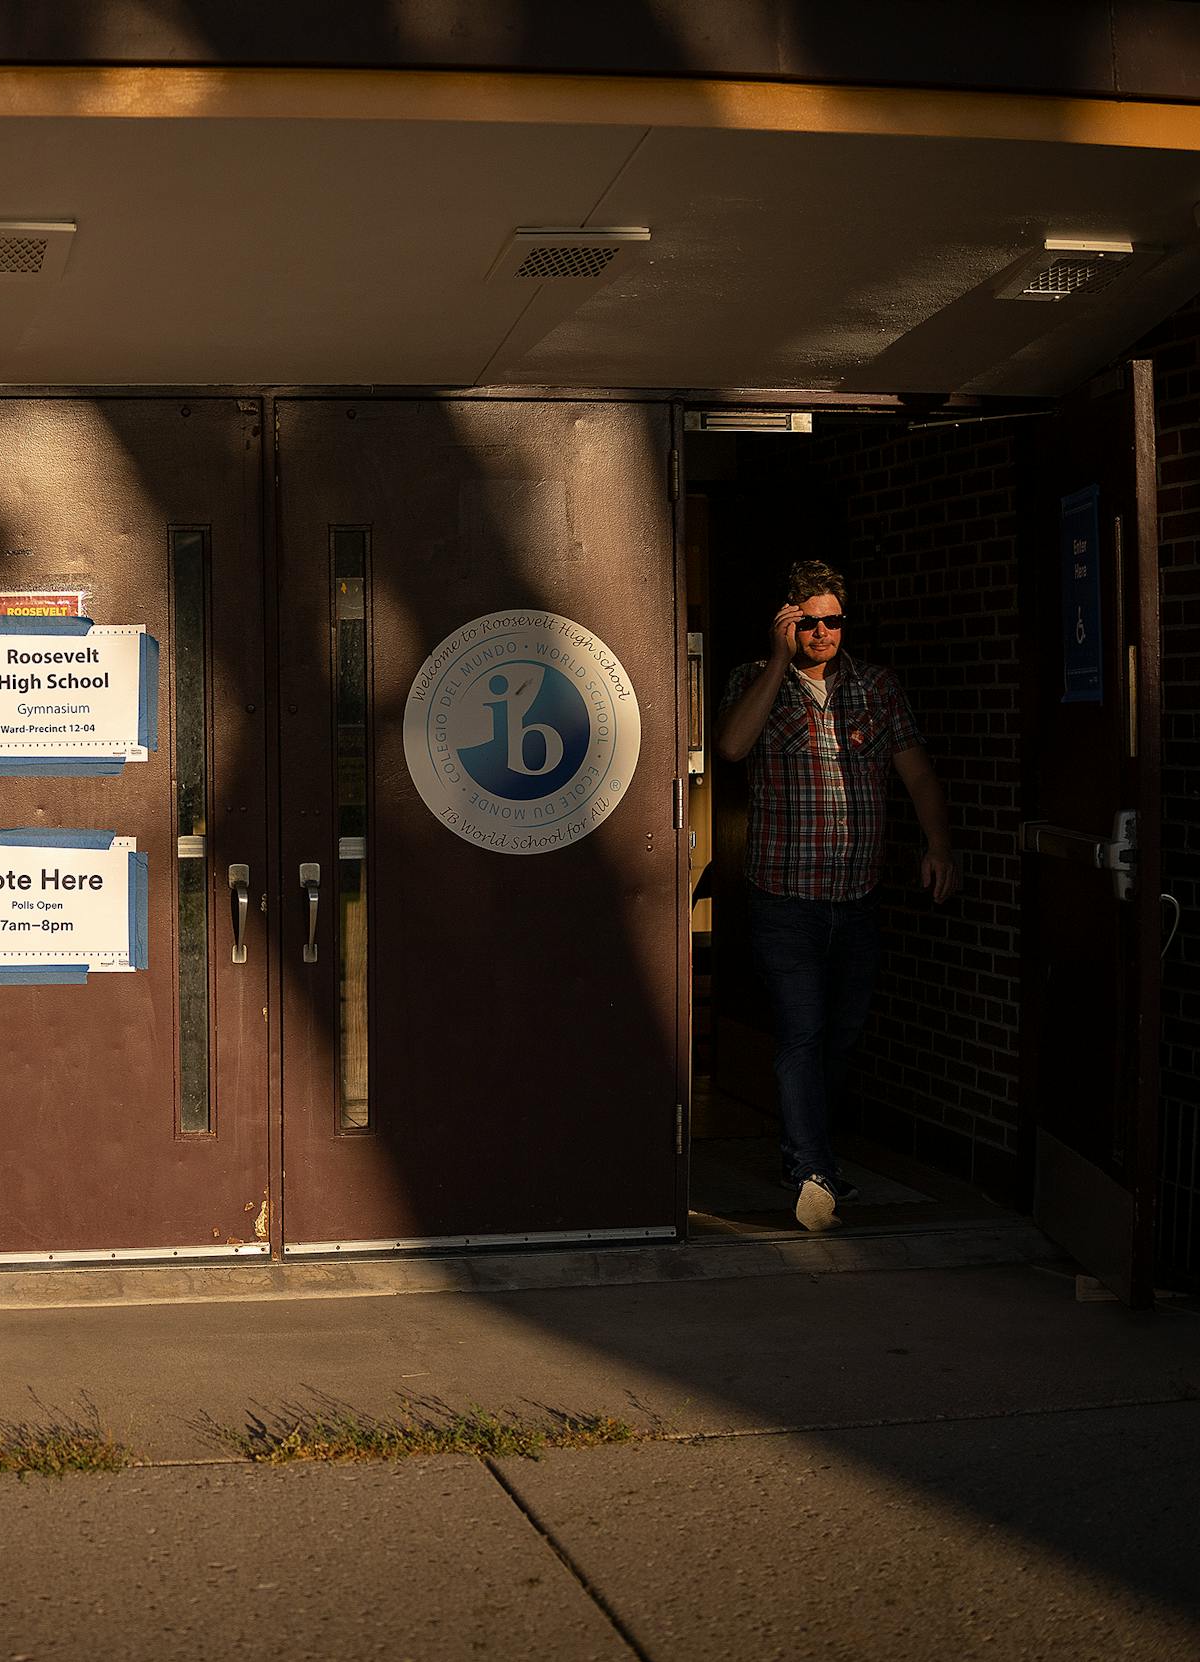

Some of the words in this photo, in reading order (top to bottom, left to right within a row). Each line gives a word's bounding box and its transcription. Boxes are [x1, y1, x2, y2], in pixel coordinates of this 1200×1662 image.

[6, 607, 68, 616] ROOSEVELT
[6, 647, 100, 665] Roosevelt
[412, 639, 461, 702] Welcome
[462, 628, 479, 642] to
[480, 615, 558, 634] Roosevelt
[558, 623, 597, 652] High
[593, 650, 631, 701] School
[460, 641, 517, 677] MUNDO
[47, 672, 110, 690] School
[441, 679, 463, 713] DEL
[536, 642, 586, 678] WORLD
[584, 680, 609, 745] SCHOOL
[17, 702, 91, 718] Gymnasium
[0, 724, 67, 735] Ward-Precinct
[69, 723, 96, 733] 12-04
[435, 713, 461, 784] COLEGIO
[468, 791, 526, 820] MONDE
[533, 803, 556, 818] DU
[439, 806, 460, 825] IB
[460, 819, 510, 848] World
[511, 828, 566, 850] School
[566, 818, 588, 840] for
[590, 796, 611, 822] All
[40, 868, 104, 891] Here
[11, 900, 35, 910] Polls
[36, 900, 64, 912] Open
